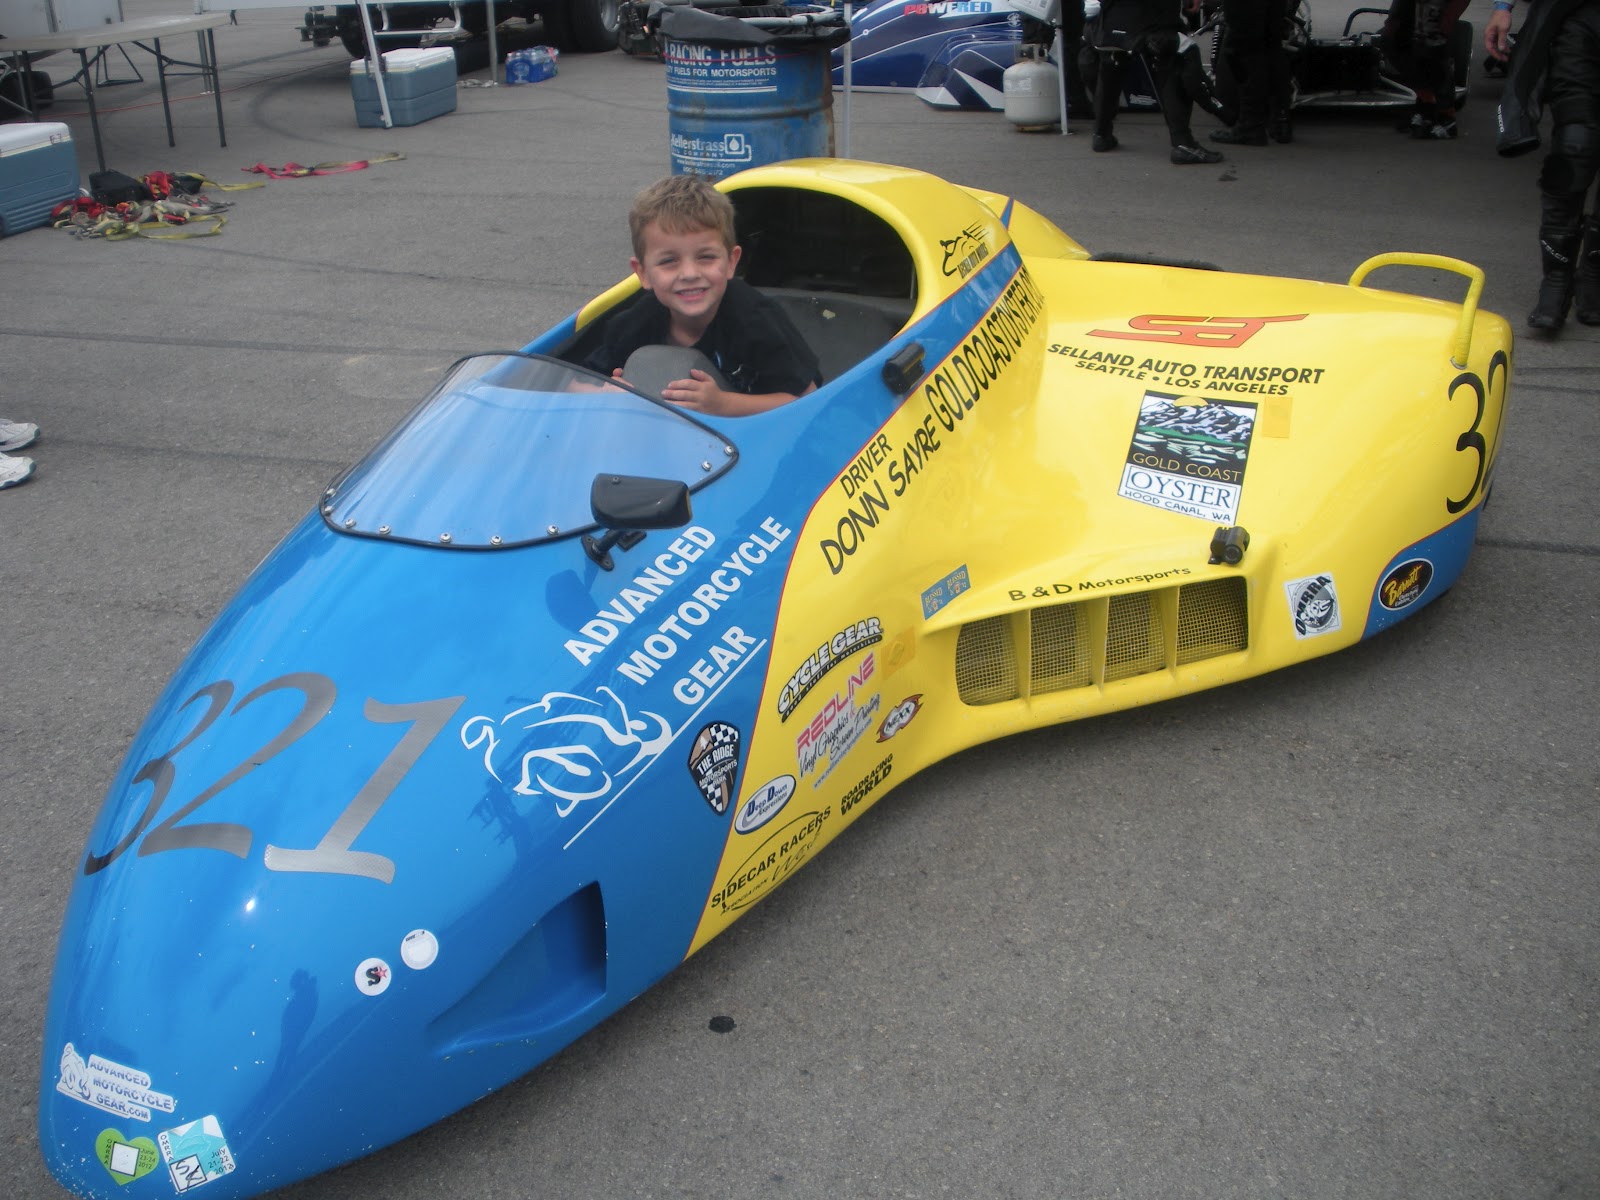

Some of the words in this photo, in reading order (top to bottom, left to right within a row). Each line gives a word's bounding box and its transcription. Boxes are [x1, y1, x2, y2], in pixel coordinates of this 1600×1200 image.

[904, 1, 992, 16] POWERED
[670, 43, 712, 66] RACING
[720, 45, 777, 67] FUELS
[674, 67, 691, 76] FUELS
[692, 68, 708, 77] FOR
[710, 67, 777, 77] MOTORSPORTS
[683, 150, 724, 158] COMPANY
[1047, 343, 1135, 367] SELLAND
[1138, 358, 1196, 377] AUTO
[1202, 365, 1325, 384] TRANSPORT
[1075, 360, 1146, 380] SEATTLE
[1164, 376, 1201, 389] LOS
[1205, 381, 1288, 396] ANGELES
[839, 432, 892, 499] DRIVER
[1132, 452, 1180, 471] GOLD
[1185, 462, 1241, 482] COAST
[820, 479, 890, 575] DONN
[888, 413, 941, 497] SAYRE
[1124, 489, 1160, 505] HOOD
[1212, 512, 1231, 522] WA
[1129, 471, 1231, 509] OYSTER
[563, 525, 716, 666] ADVANCED
[616, 516, 792, 685] MOTORCYCLE
[1008, 589, 1026, 601] B
[1032, 587, 1049, 598] &
[1053, 583, 1073, 595] D
[1078, 567, 1191, 592] Motorsports
[672, 625, 757, 705] GEAR
[778, 641, 831, 714] CYCLE
[831, 616, 882, 656] GEAR
[797, 652, 874, 758] REDLINE
[697, 754, 712, 775] THE
[712, 744, 734, 763] RIDGE
[699, 760, 738, 787] MOTORSPORTS
[84, 671, 467, 885] 321
[712, 774, 727, 786] PARK
[841, 753, 893, 805] ROADRACING
[841, 764, 892, 816] WORLD
[747, 799, 767, 817] Deep
[767, 784, 787, 802] Down
[711, 852, 776, 908] SIDECAR
[779, 806, 831, 858] RACERS
[90, 1061, 149, 1087] ADVANCED
[93, 1077, 172, 1110] MOTORCYCLE
[96, 1093, 149, 1119] GEAR.COM
[160, 1134, 174, 1162] OMRRA
[208, 1156, 230, 1168] 21-22
[211, 1148, 226, 1159] July
